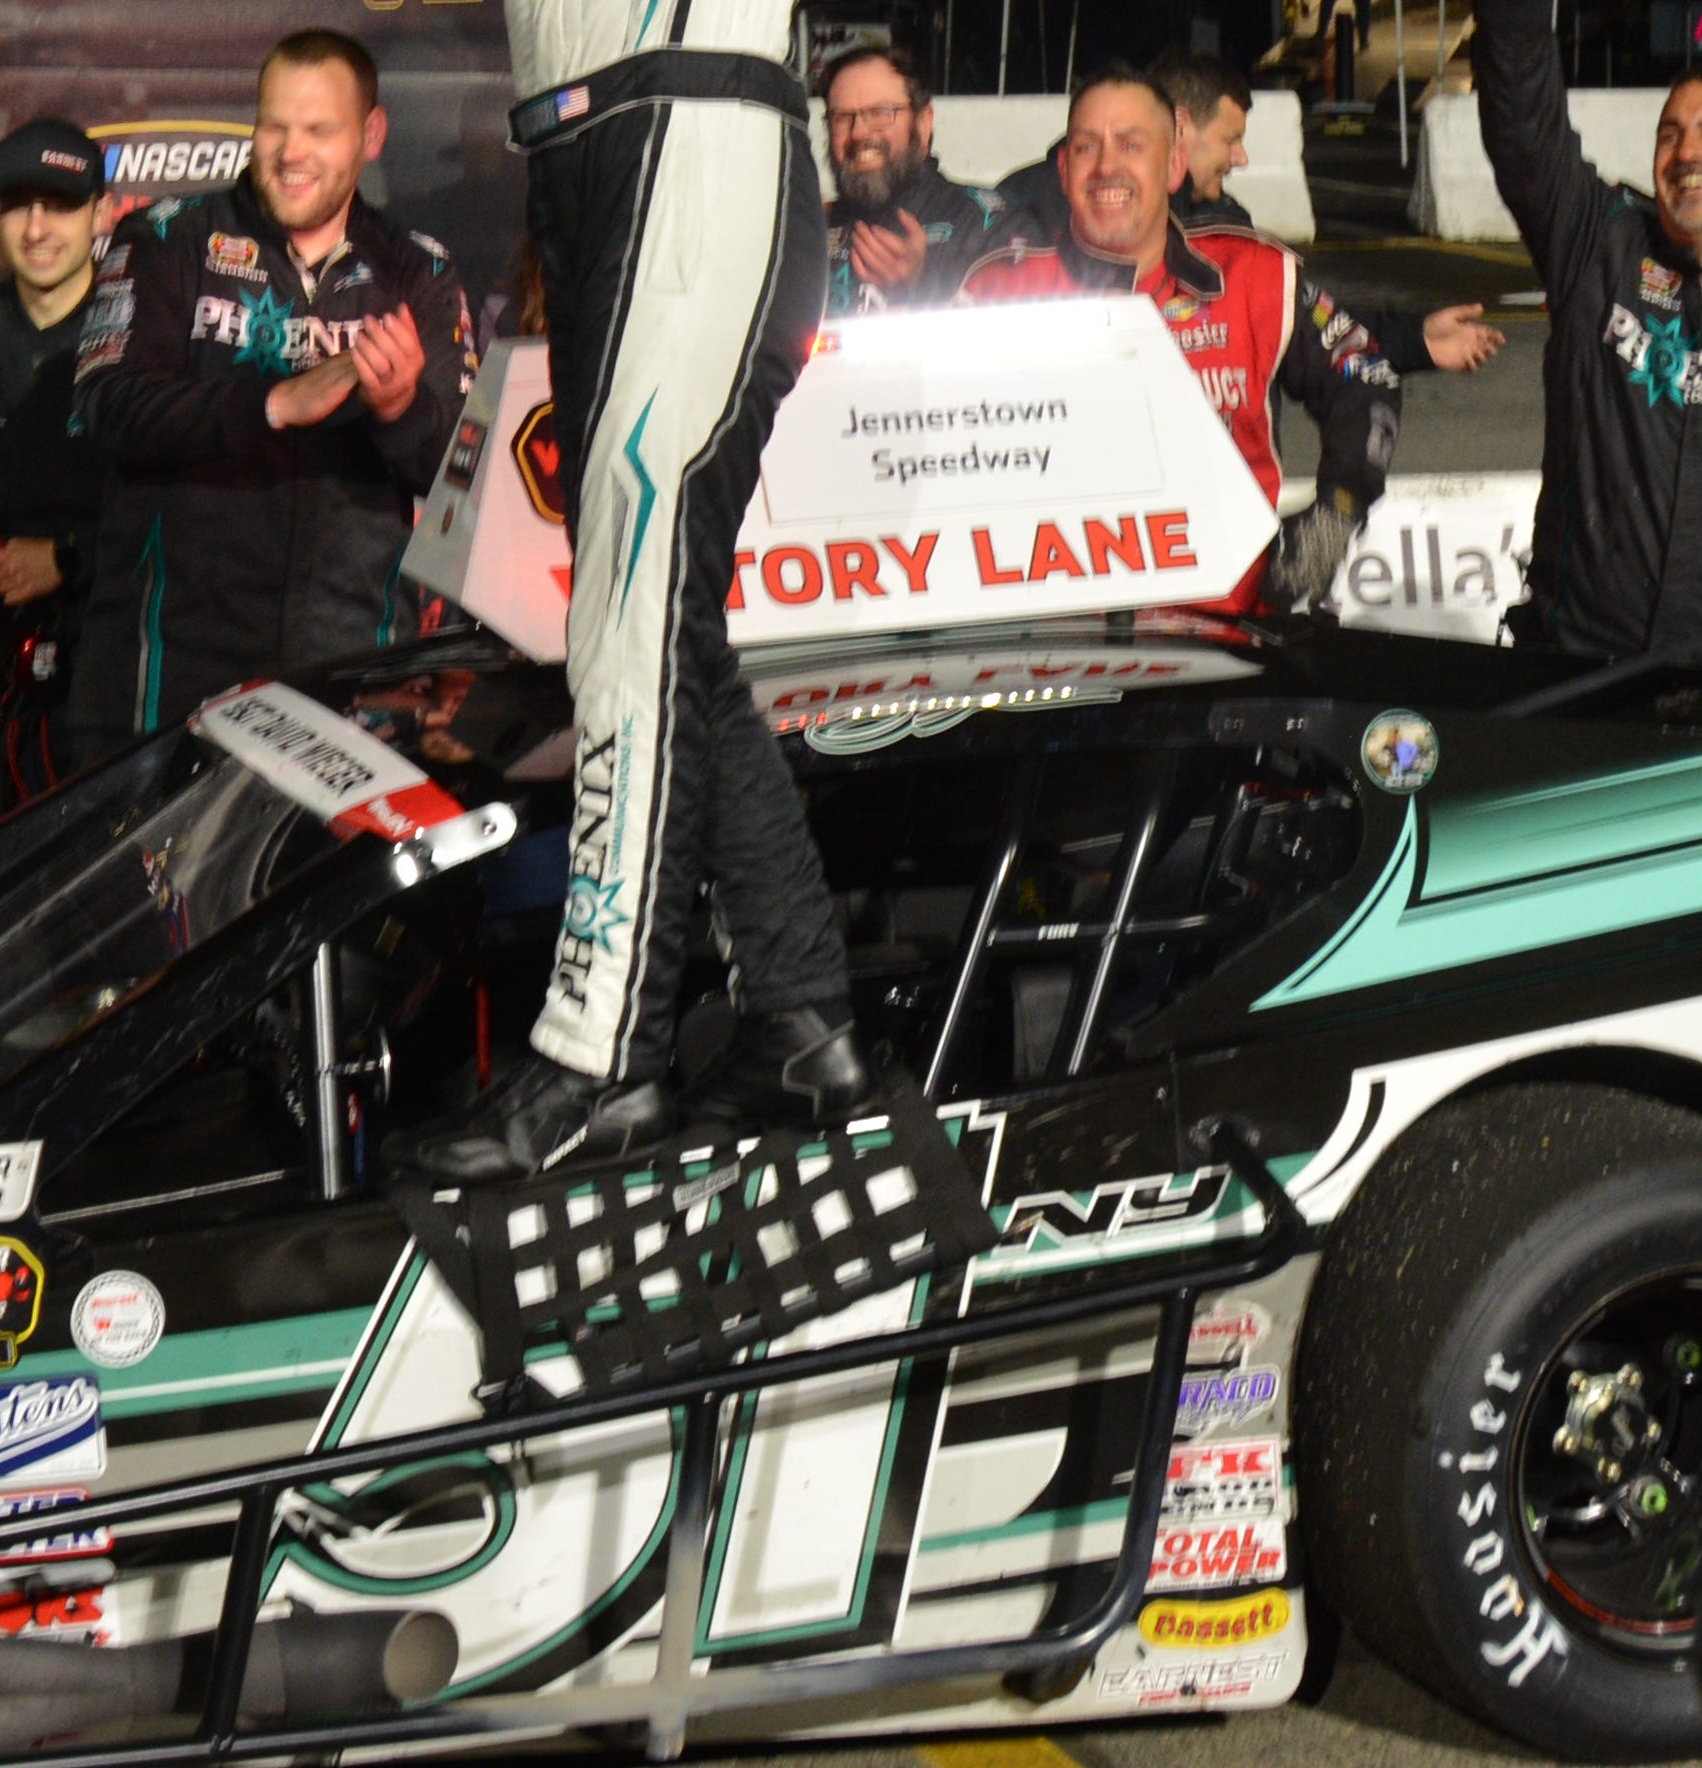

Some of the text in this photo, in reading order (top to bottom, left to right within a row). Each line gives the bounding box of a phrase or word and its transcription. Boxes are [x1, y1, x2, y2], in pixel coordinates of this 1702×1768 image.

[841, 394, 1068, 438] Jennerstown
[871, 444, 1053, 484] Speedway
[727, 509, 1198, 613] TORY LANE
[1154, 1602, 1274, 1640] Bassett
